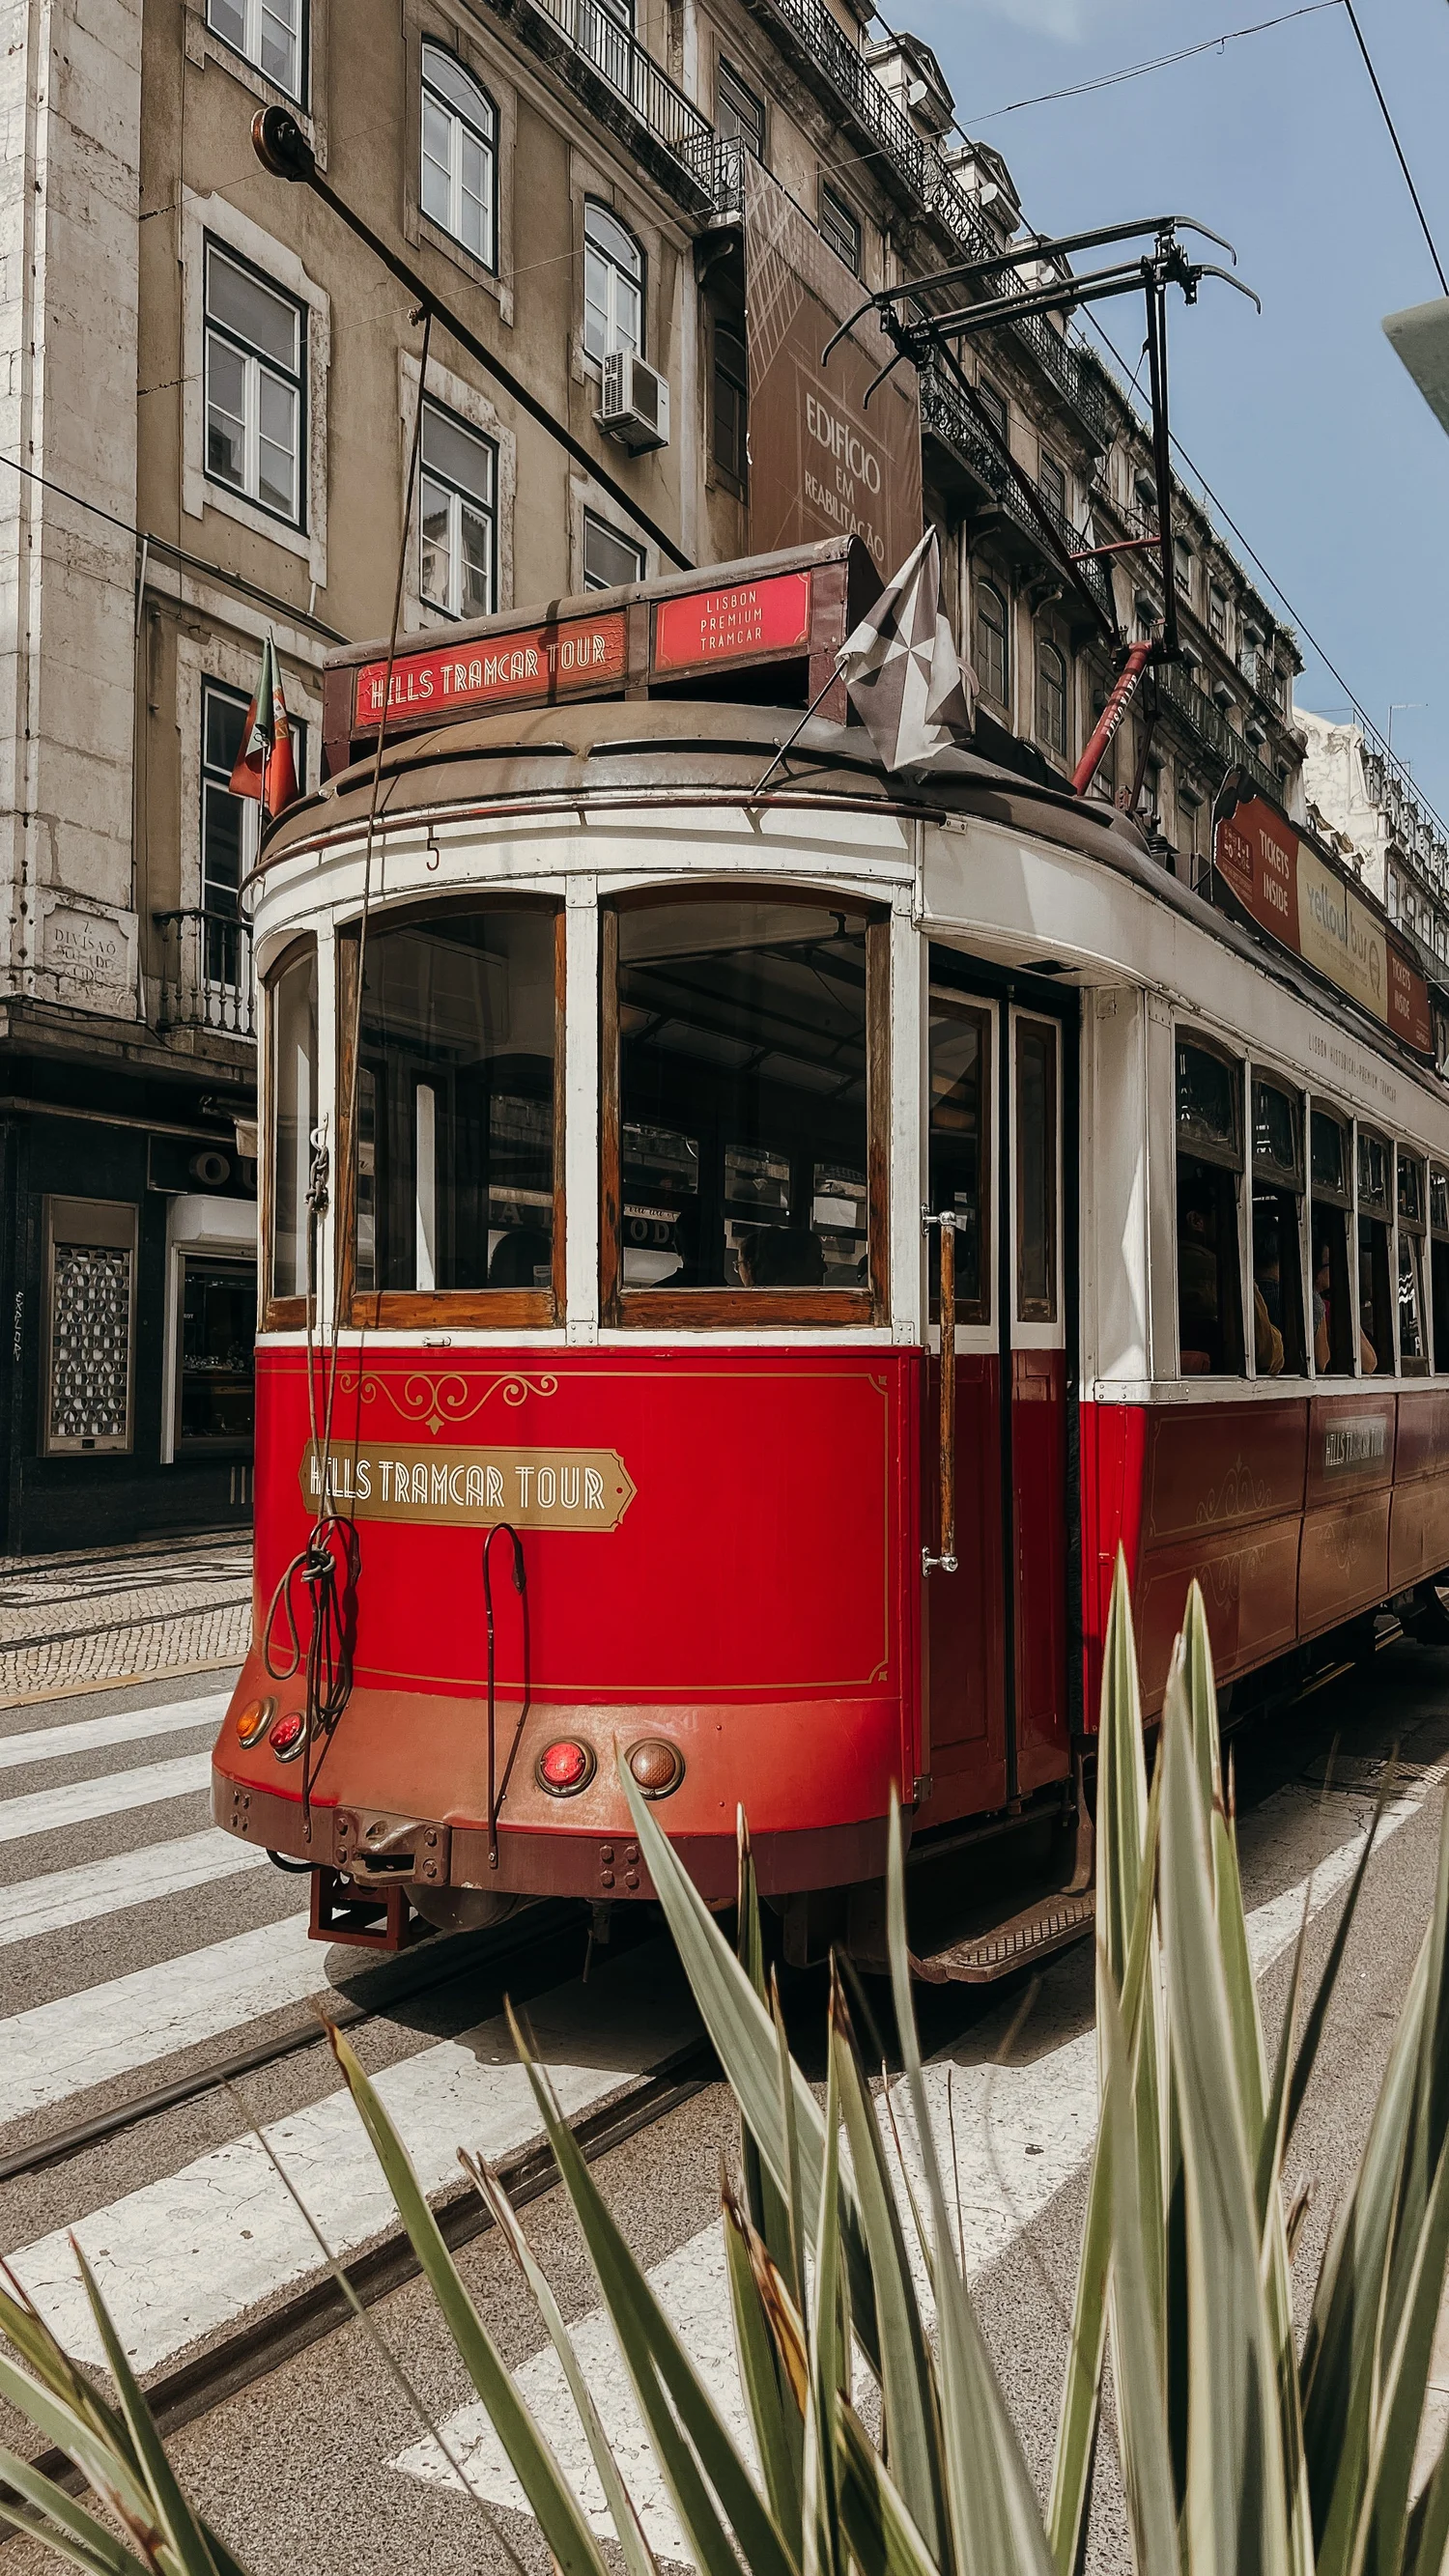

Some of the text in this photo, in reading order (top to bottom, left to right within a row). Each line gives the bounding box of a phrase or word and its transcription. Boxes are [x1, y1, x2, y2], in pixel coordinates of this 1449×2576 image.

[806, 393, 881, 495] EDIFÍCIO
[836, 466, 855, 504] EM
[700, 608, 763, 633] PREMIUM
[706, 590, 756, 613] LISBON
[700, 627, 762, 651] TRAMCAR
[371, 634, 607, 709] HILLS TRAMCAR TOUR
[1259, 828, 1290, 880] TICKETS
[1263, 871, 1289, 917] INSIDE
[1392, 957, 1411, 992] TICKETS
[1308, 1031, 1327, 1059] LISBON
[310, 1456, 606, 1510] HILLS TRAMCAR TOUR
